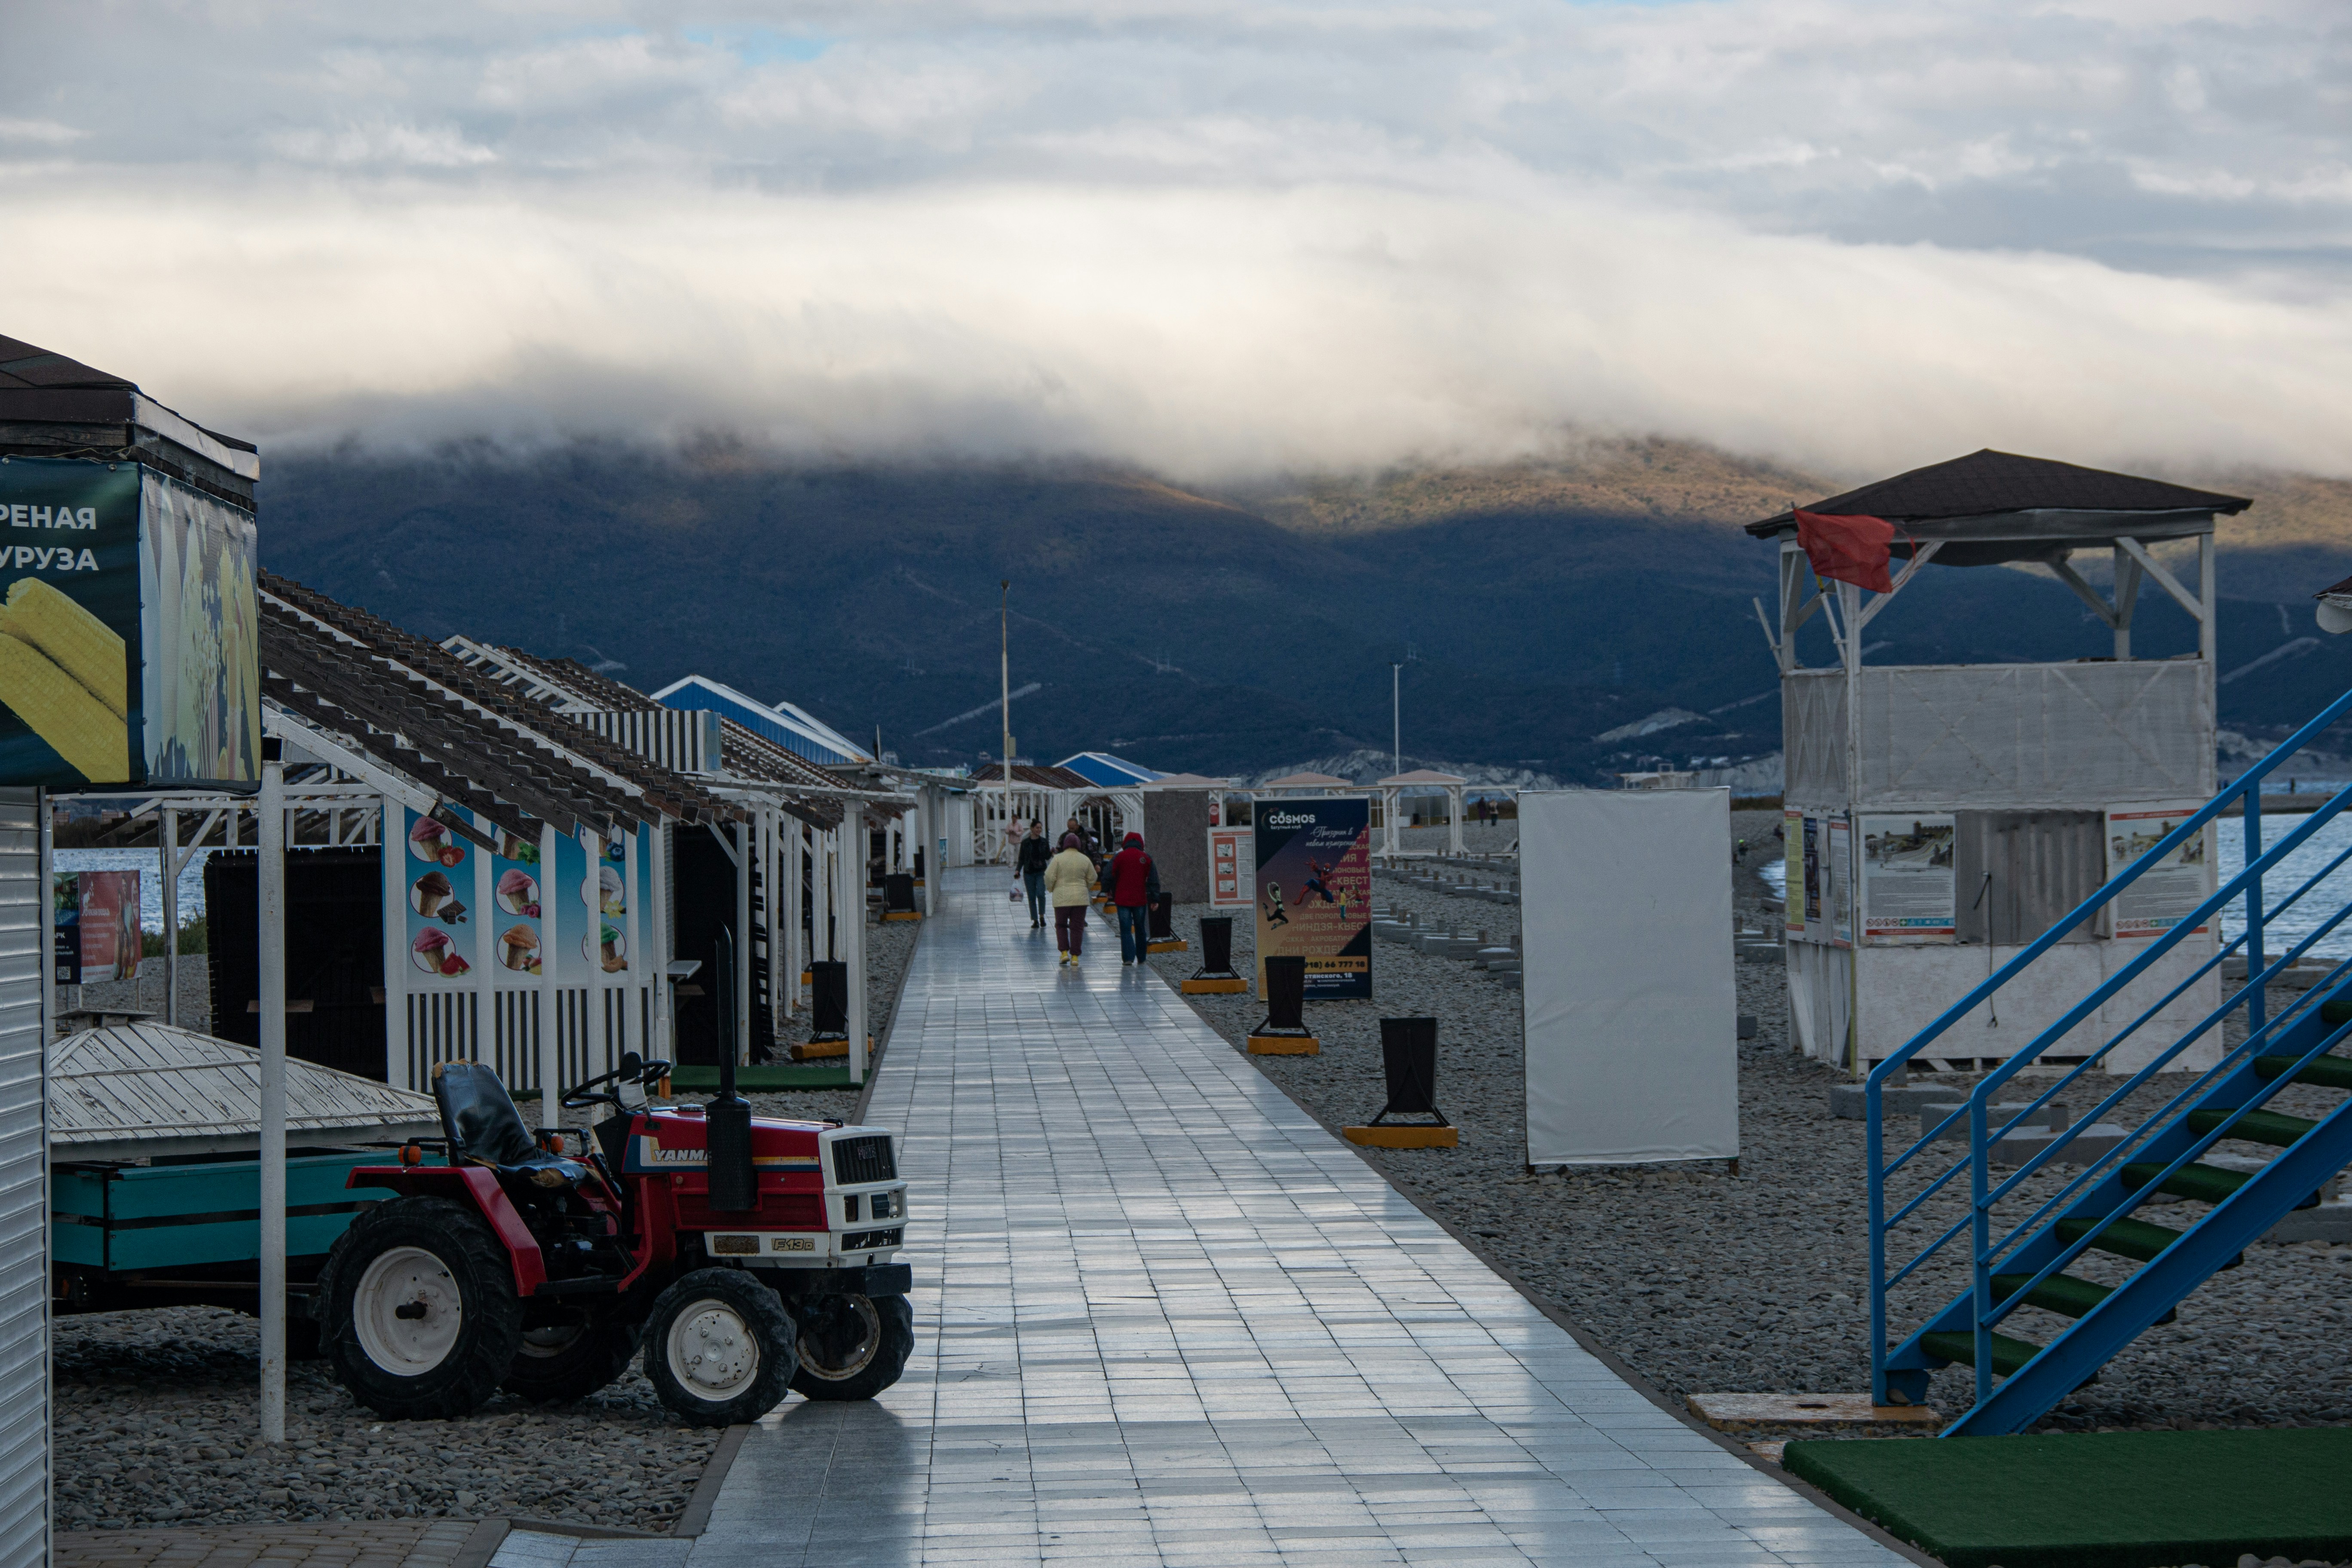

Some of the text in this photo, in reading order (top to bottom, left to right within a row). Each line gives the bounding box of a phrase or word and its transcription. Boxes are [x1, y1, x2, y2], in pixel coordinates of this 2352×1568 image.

[1269, 814, 1315, 824] COSMOS
[1309, 826, 1347, 838] Праздник
[654, 1149, 708, 1162] YANM
[773, 1238, 814, 1250] F13D
